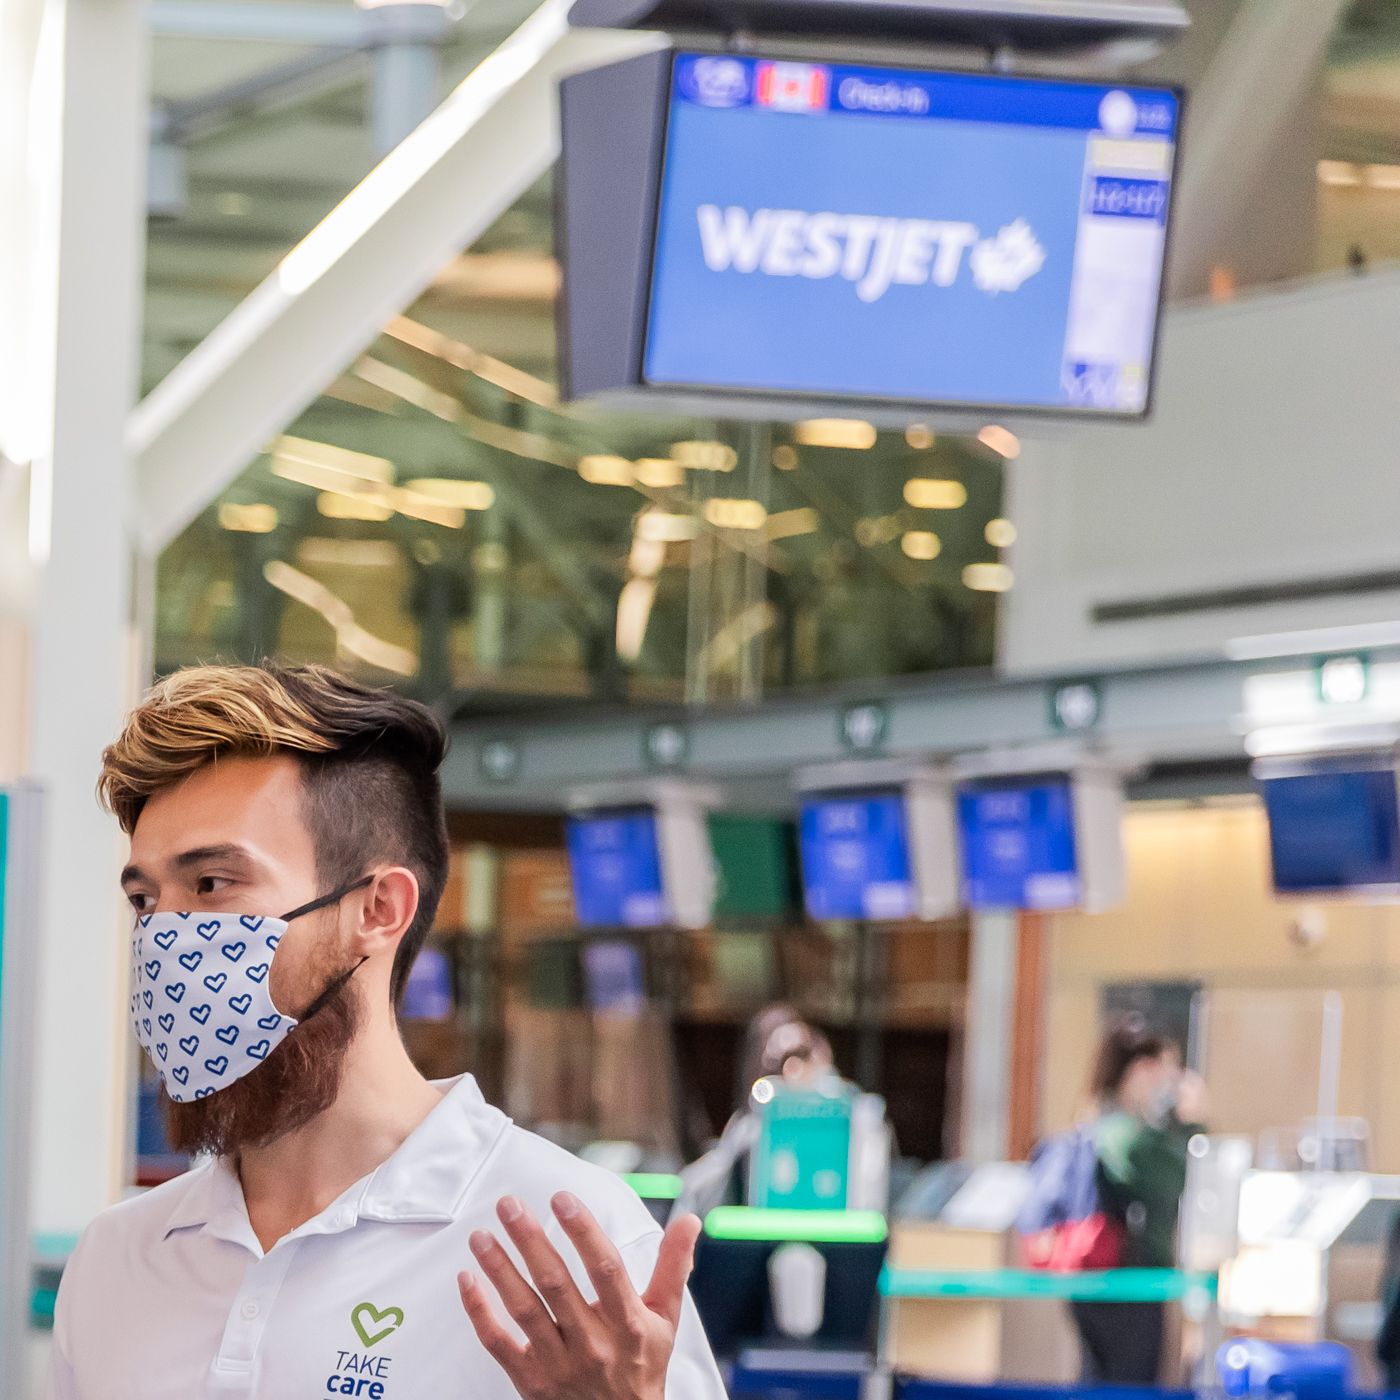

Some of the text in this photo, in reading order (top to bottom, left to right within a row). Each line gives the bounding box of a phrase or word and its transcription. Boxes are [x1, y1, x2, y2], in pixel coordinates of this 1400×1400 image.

[696, 202, 980, 303] WESTJET
[336, 1350, 393, 1379] TAKE
[326, 1374, 385, 1400] care
